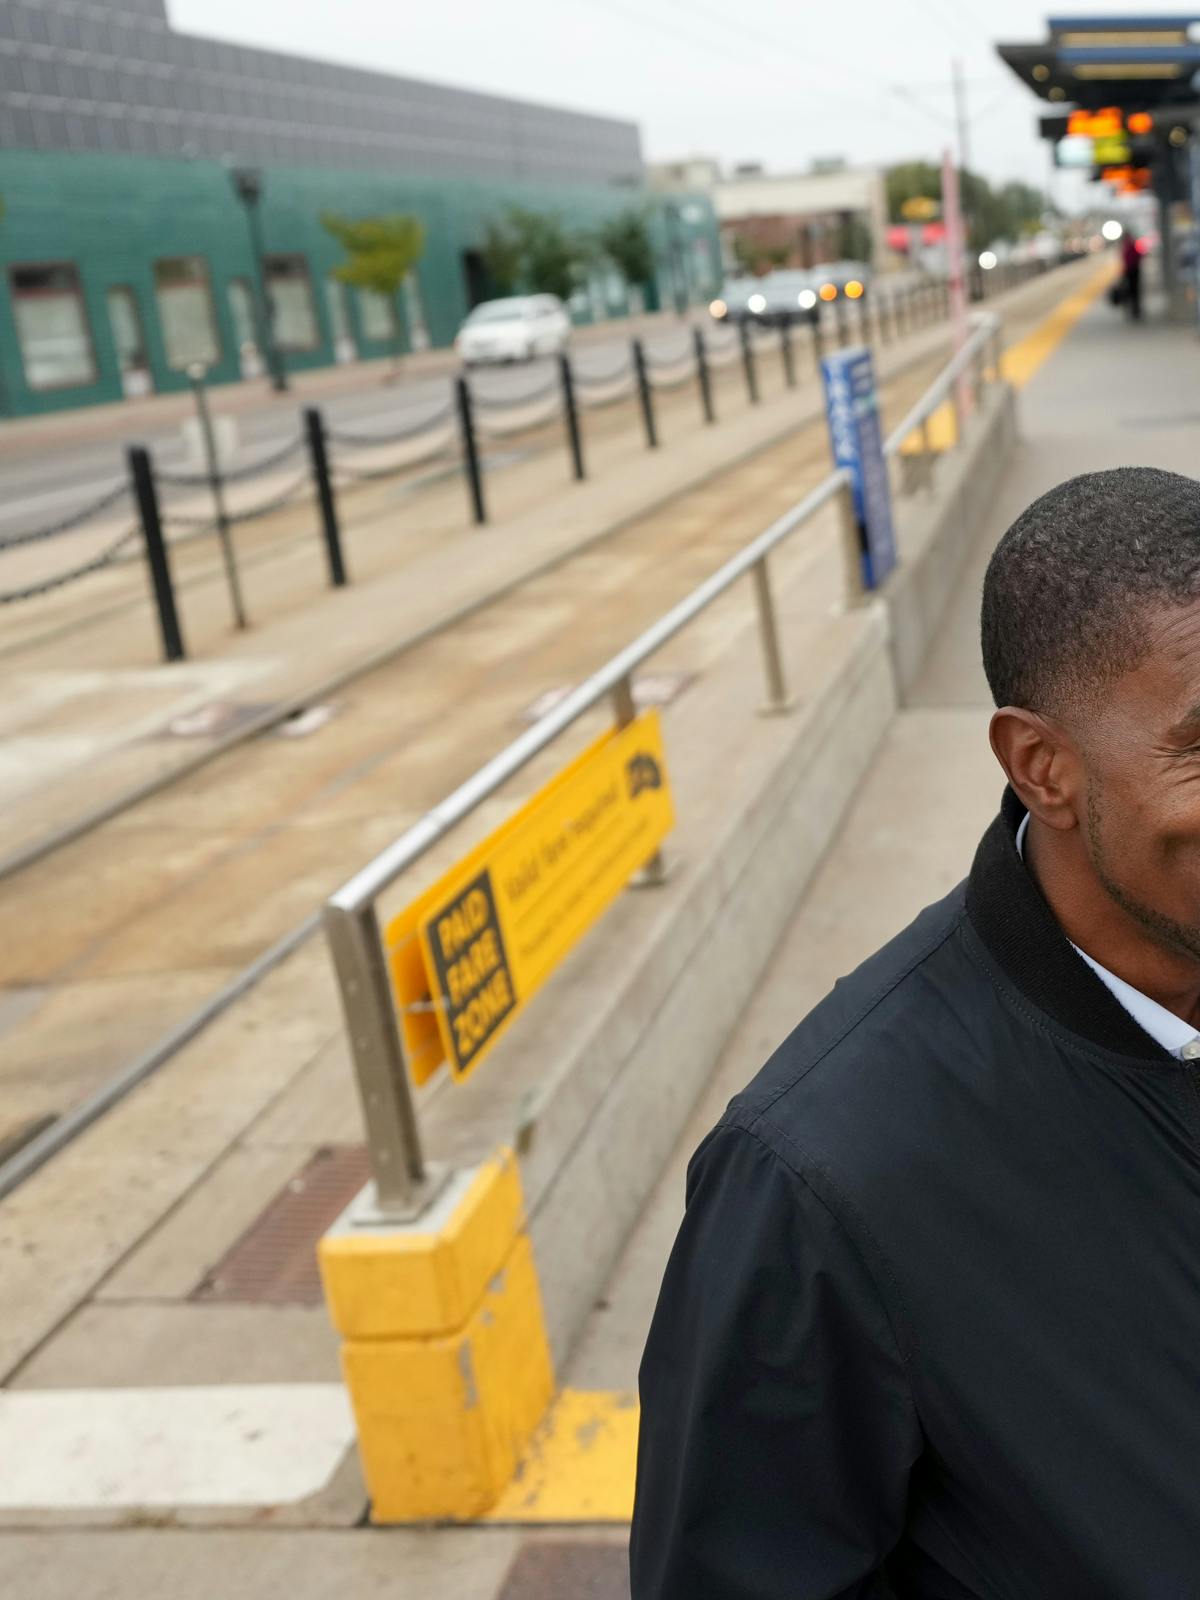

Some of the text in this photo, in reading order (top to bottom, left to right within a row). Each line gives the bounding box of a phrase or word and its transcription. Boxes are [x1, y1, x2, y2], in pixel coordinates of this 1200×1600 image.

[437, 889, 489, 959] PAID
[446, 928, 499, 1000] FARE
[453, 968, 511, 1055] ZONE
